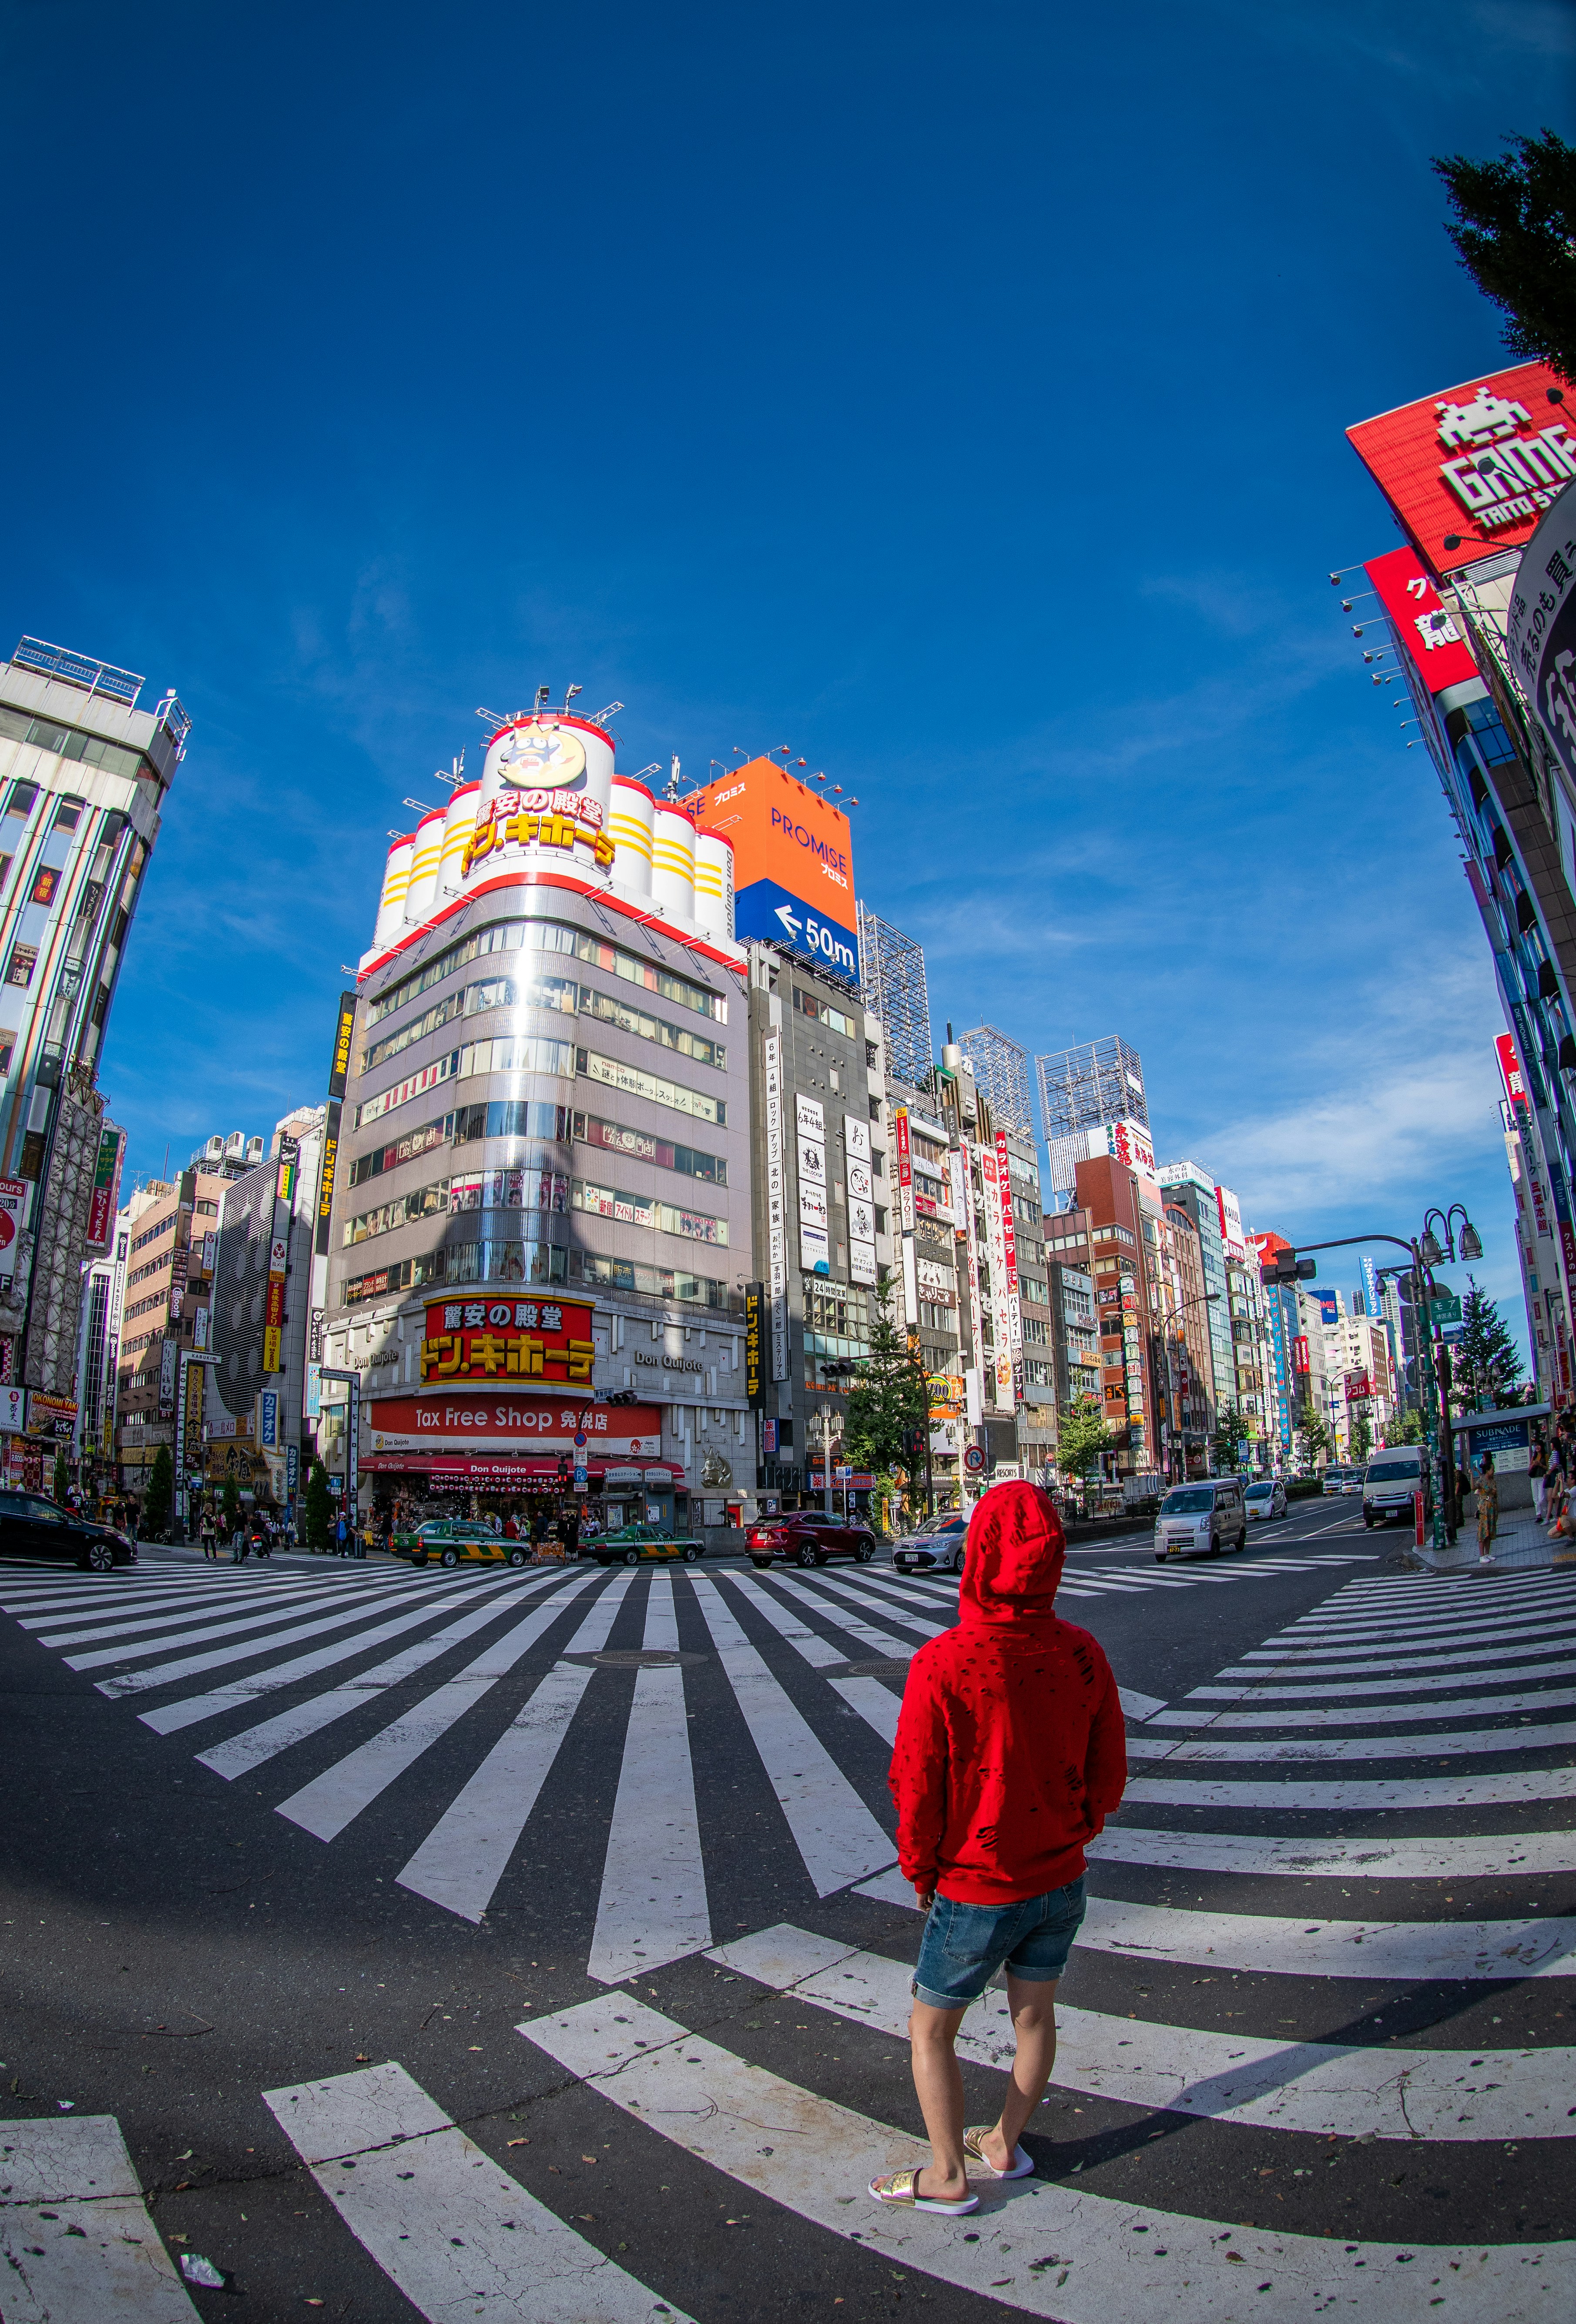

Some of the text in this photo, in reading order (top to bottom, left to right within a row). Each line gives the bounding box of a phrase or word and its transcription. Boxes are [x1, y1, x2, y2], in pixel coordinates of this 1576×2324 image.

[1473, 495, 1536, 528] TAITO
[1406, 577, 1428, 600] ク
[714, 782, 746, 806] プロミス
[476, 789, 603, 829] 驚安の殿堂
[771, 807, 846, 875] PROMISE
[821, 863, 848, 890] プロミス
[39, 877, 52, 898] 新宿
[806, 917, 854, 967] 50m
[1514, 1008, 1530, 1050] DIET WOMAN
[336, 1013, 353, 1073] 驚安の殿堂
[602, 1061, 625, 1074] namco
[798, 1112, 823, 1131] 6年4組
[897, 1108, 906, 1117] 8F
[1516, 1105, 1536, 1175] 新宿サンパーク
[1160, 1171, 1188, 1184] 美容外科
[1169, 1164, 1187, 1174] 水の森
[95, 1196, 106, 1239] ひょうたん
[600, 1199, 653, 1225] 新宿 アイドル ステージ
[1224, 1204, 1240, 1224] KAIUL
[614, 1264, 632, 1279] 販売
[852, 1263, 876, 1275] 新宿東口会議室
[859, 1258, 872, 1267] オフィス
[376, 1275, 387, 1285] 時計
[635, 1272, 653, 1281] ブランド
[657, 1275, 673, 1286] 時計
[815, 1282, 847, 1298] 24時間営業
[1365, 1267, 1378, 1315] オザキクリニック
[173, 1287, 182, 1318] Booth
[1434, 1298, 1456, 1311] モア
[444, 1304, 562, 1330] 驚安の殿堂
[774, 1300, 782, 1330] ふぐ一郎
[1010, 1297, 1018, 1336] パーティー
[1435, 1310, 1457, 1321] 靖国通り
[353, 1351, 398, 1369] Don Quijote
[636, 1351, 704, 1372] Don Quijote
[1014, 1365, 1023, 1392] ダーツ
[178, 1369, 186, 1432] GODZILLA
[1345, 1385, 1365, 1398] アコム
[34, 1393, 79, 1410] OKONOMI YAKI
[220, 1421, 235, 1434] 鳥メロ
[264, 1395, 275, 1442] カラオケ
[416, 1407, 607, 1431] Tax Free Shop 免税店
[765, 1420, 774, 1431] 薬
[1476, 1424, 1521, 1439] SUBNADE
[394, 1439, 409, 1447] Quijote
[288, 1447, 297, 1485] カラオケ
[492, 1465, 526, 1475] Quijote
[577, 1470, 582, 1480] P
[996, 1468, 1017, 1479] RESORTS
[812, 1475, 823, 1488] 薬
[768, 1501, 772, 1511] P
